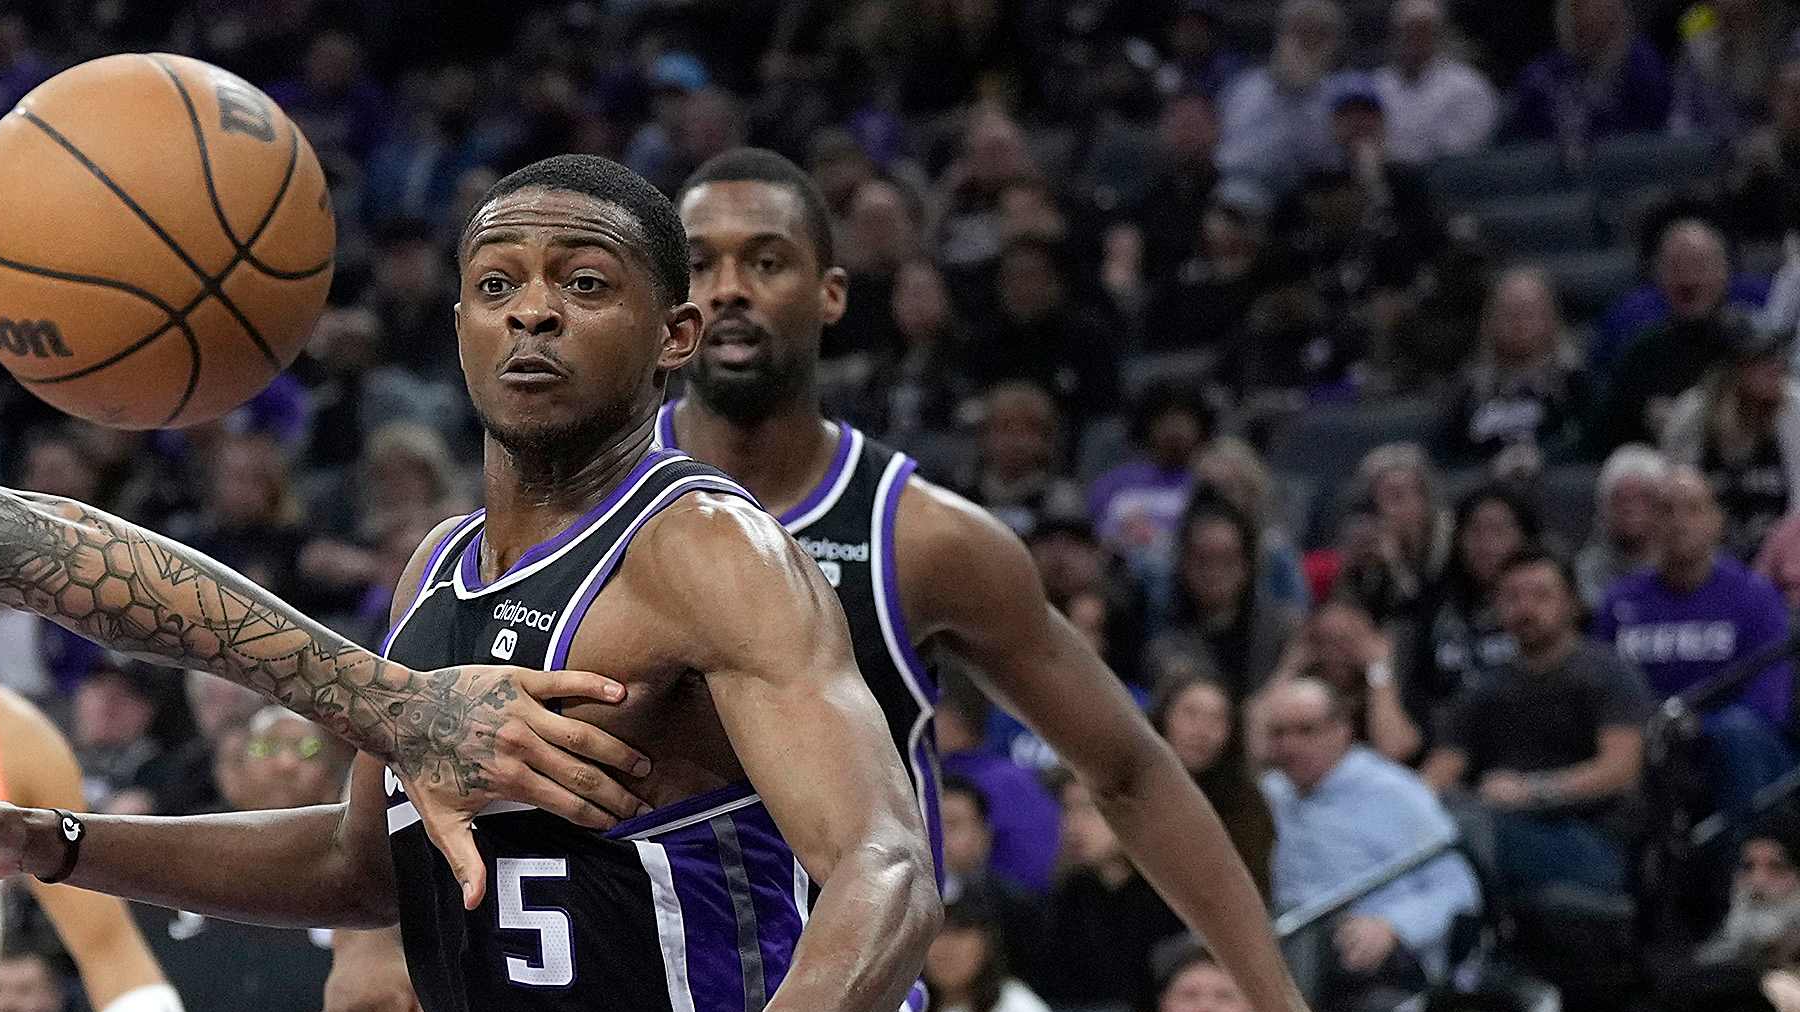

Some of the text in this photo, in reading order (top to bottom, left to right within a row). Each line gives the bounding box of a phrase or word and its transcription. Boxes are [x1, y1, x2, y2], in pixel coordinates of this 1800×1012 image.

[799, 537, 869, 562] ialpad
[493, 599, 557, 632] dialpad
[496, 857, 574, 987] 5
